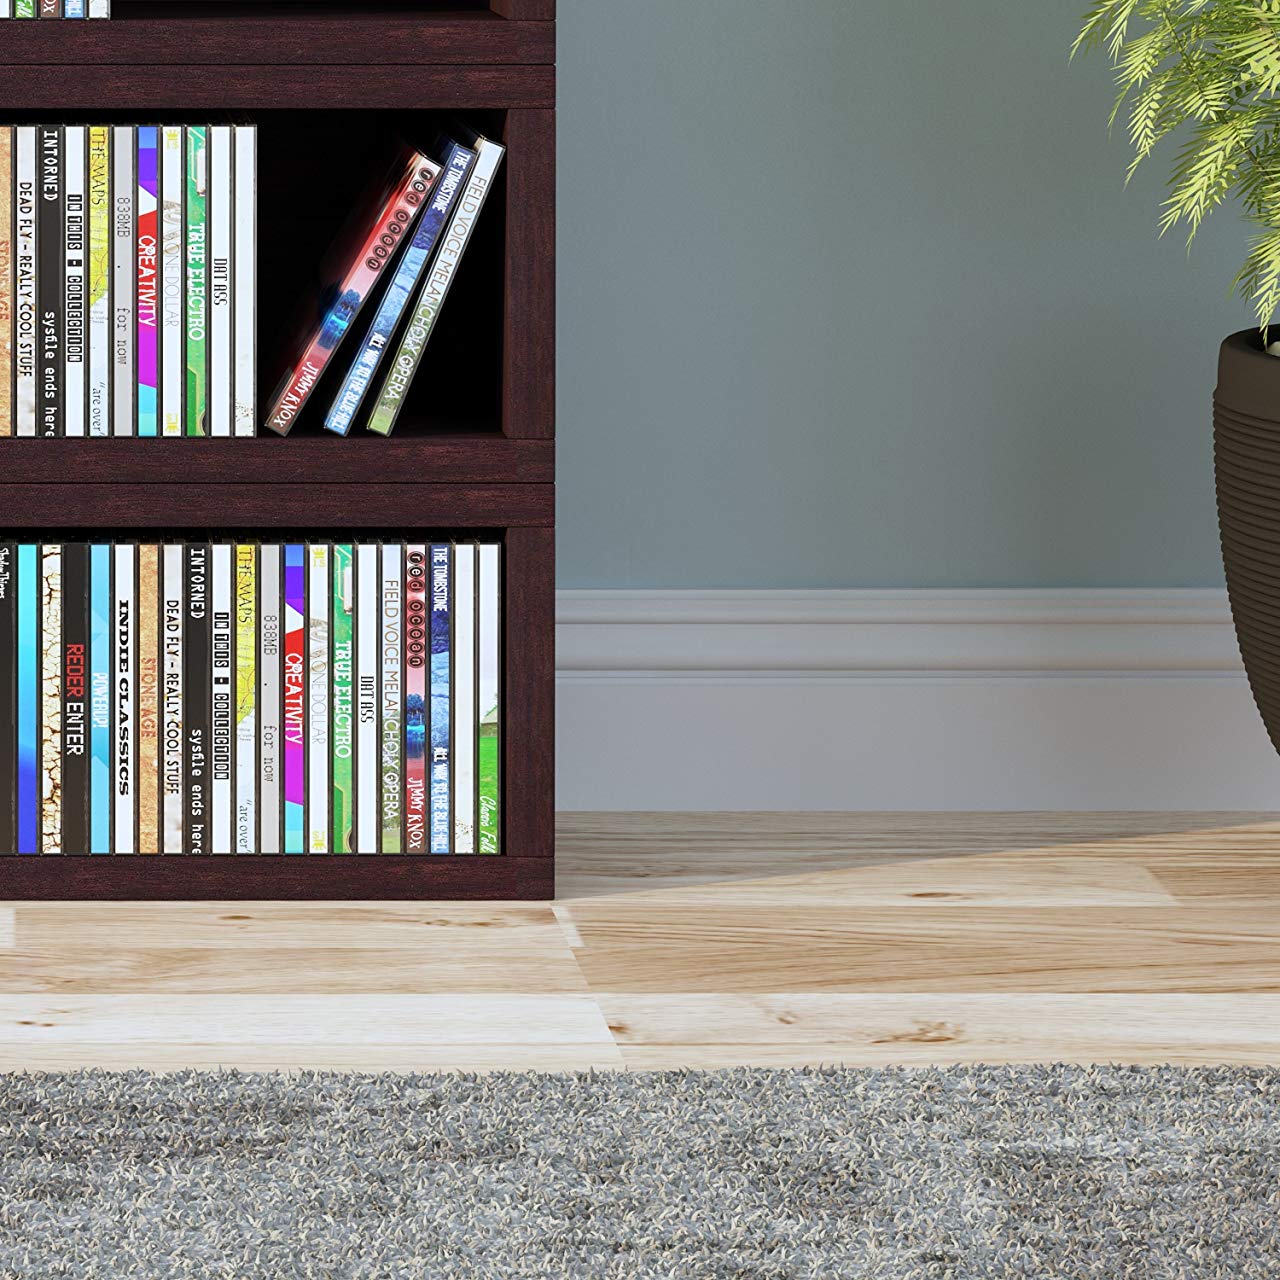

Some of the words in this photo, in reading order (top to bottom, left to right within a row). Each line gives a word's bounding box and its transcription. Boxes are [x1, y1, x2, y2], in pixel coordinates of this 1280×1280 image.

[91, 130, 104, 160] THE
[455, 151, 471, 170] THE
[43, 130, 57, 201] INTORNED
[20, 182, 32, 214] DEAD
[91, 165, 104, 205] MAPS
[432, 167, 462, 213] TOMBSTONE
[460, 175, 487, 213] FIELD
[20, 220, 32, 239] FLY
[365, 208, 411, 273] ocean
[443, 213, 468, 263] VOICE
[20, 255, 32, 297] REALLY
[138, 235, 155, 326] CREATIVITY
[213, 258, 226, 280] DAT
[213, 284, 226, 305] ASS
[404, 259, 453, 356] MELANCHOLY
[20, 304, 32, 338] COOL
[43, 312, 57, 359] sysfile
[20, 343, 32, 377] STUFF
[384, 352, 414, 399] OPERA
[45, 368, 57, 398] ends
[294, 362, 319, 396] JIMMY
[273, 392, 300, 427] KNOX
[167, 600, 179, 631] DEAD
[214, 612, 228, 628] IN
[120, 600, 129, 673] INDIE
[167, 637, 179, 656] FLY
[214, 634, 228, 667] THIS
[264, 615, 276, 655] 838MB
[407, 599, 424, 668] ocean
[66, 644, 84, 697] REDER
[311, 661, 325, 689] ONE
[360, 676, 373, 698] DAT
[167, 673, 179, 715] REALLY
[66, 702, 84, 755] ENTER
[311, 694, 325, 744] DOLLAR
[360, 702, 373, 722] ASS
[119, 678, 129, 795] CLASSICS
[167, 721, 179, 755] COOL
[214, 693, 228, 779] COLLECTION
[264, 725, 277, 749] for
[167, 761, 179, 794] STUFF
[264, 757, 273, 781] now
[408, 777, 423, 810] JIMMY
[480, 796, 496, 826] Classic
[407, 814, 422, 848] KNOX
[480, 831, 496, 852] Folk
